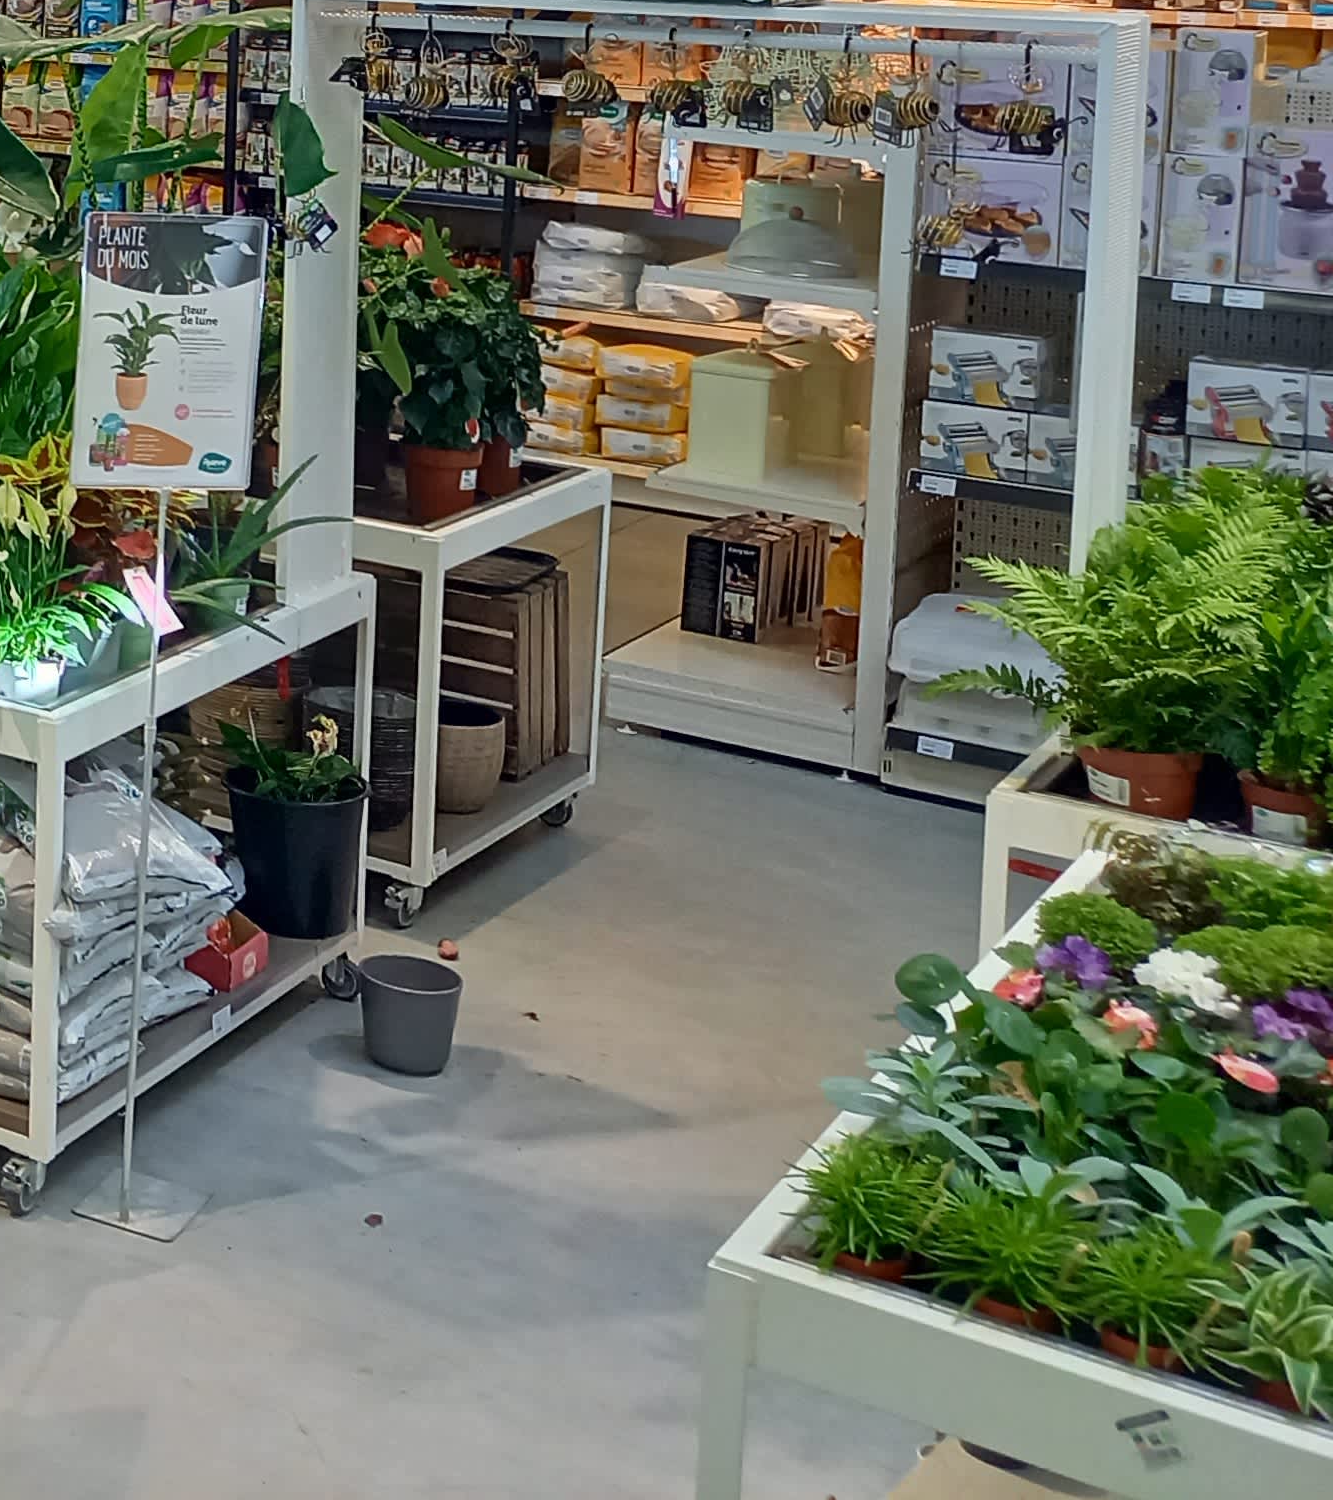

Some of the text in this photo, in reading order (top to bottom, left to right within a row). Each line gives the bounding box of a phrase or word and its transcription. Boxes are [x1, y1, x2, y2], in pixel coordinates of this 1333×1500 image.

[97, 225, 146, 247] PLANTE
[96, 248, 149, 271] DU MOIS
[180, 315, 194, 325] de
